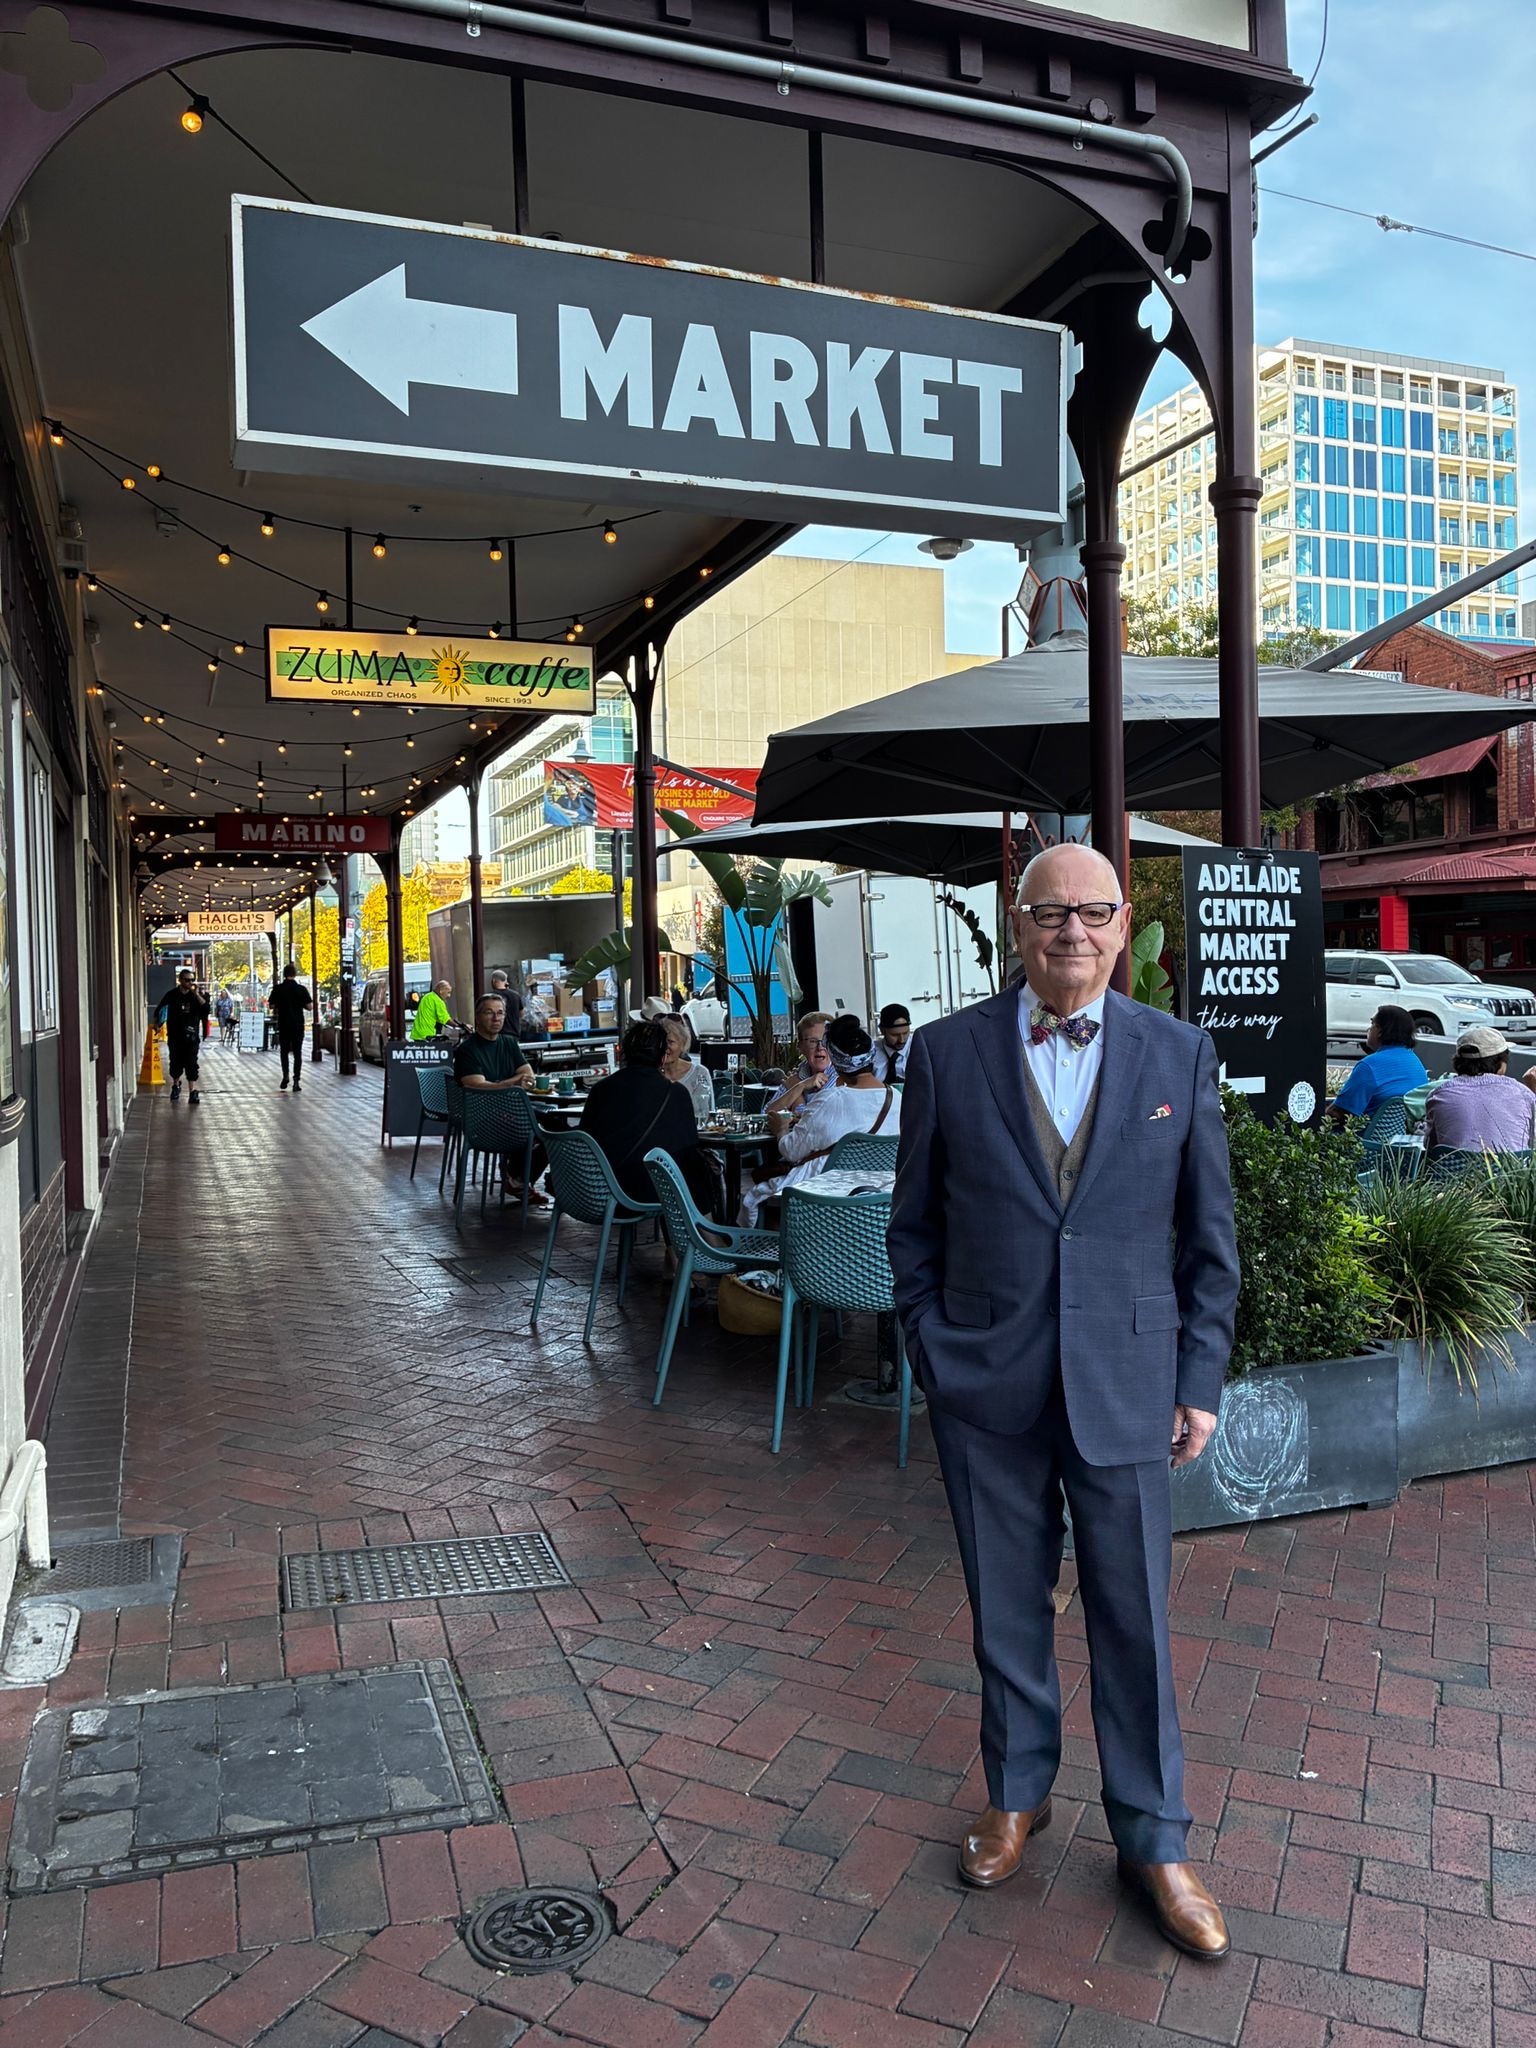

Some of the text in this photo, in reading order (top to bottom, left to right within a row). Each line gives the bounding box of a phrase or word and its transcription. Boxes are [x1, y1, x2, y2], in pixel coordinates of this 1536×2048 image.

[559, 304, 1022, 467] MARKET
[288, 646, 584, 697] ZUMA caffe
[331, 689, 417, 699] ORGANIZED CHAOS
[485, 696, 532, 705] SINCE 1993
[664, 798, 681, 808] THE
[683, 799, 719, 809] MARKET
[242, 823, 365, 842] MARINO
[1198, 863, 1302, 894] ADELAIDE
[199, 913, 265, 924] HAIGH'S
[1199, 898, 1296, 927] CENTRAL
[1200, 932, 1290, 961] MARKET
[1200, 966, 1280, 996] ACCESS
[1197, 1005, 1283, 1040] this way
[391, 1049, 449, 1060] MARINO
